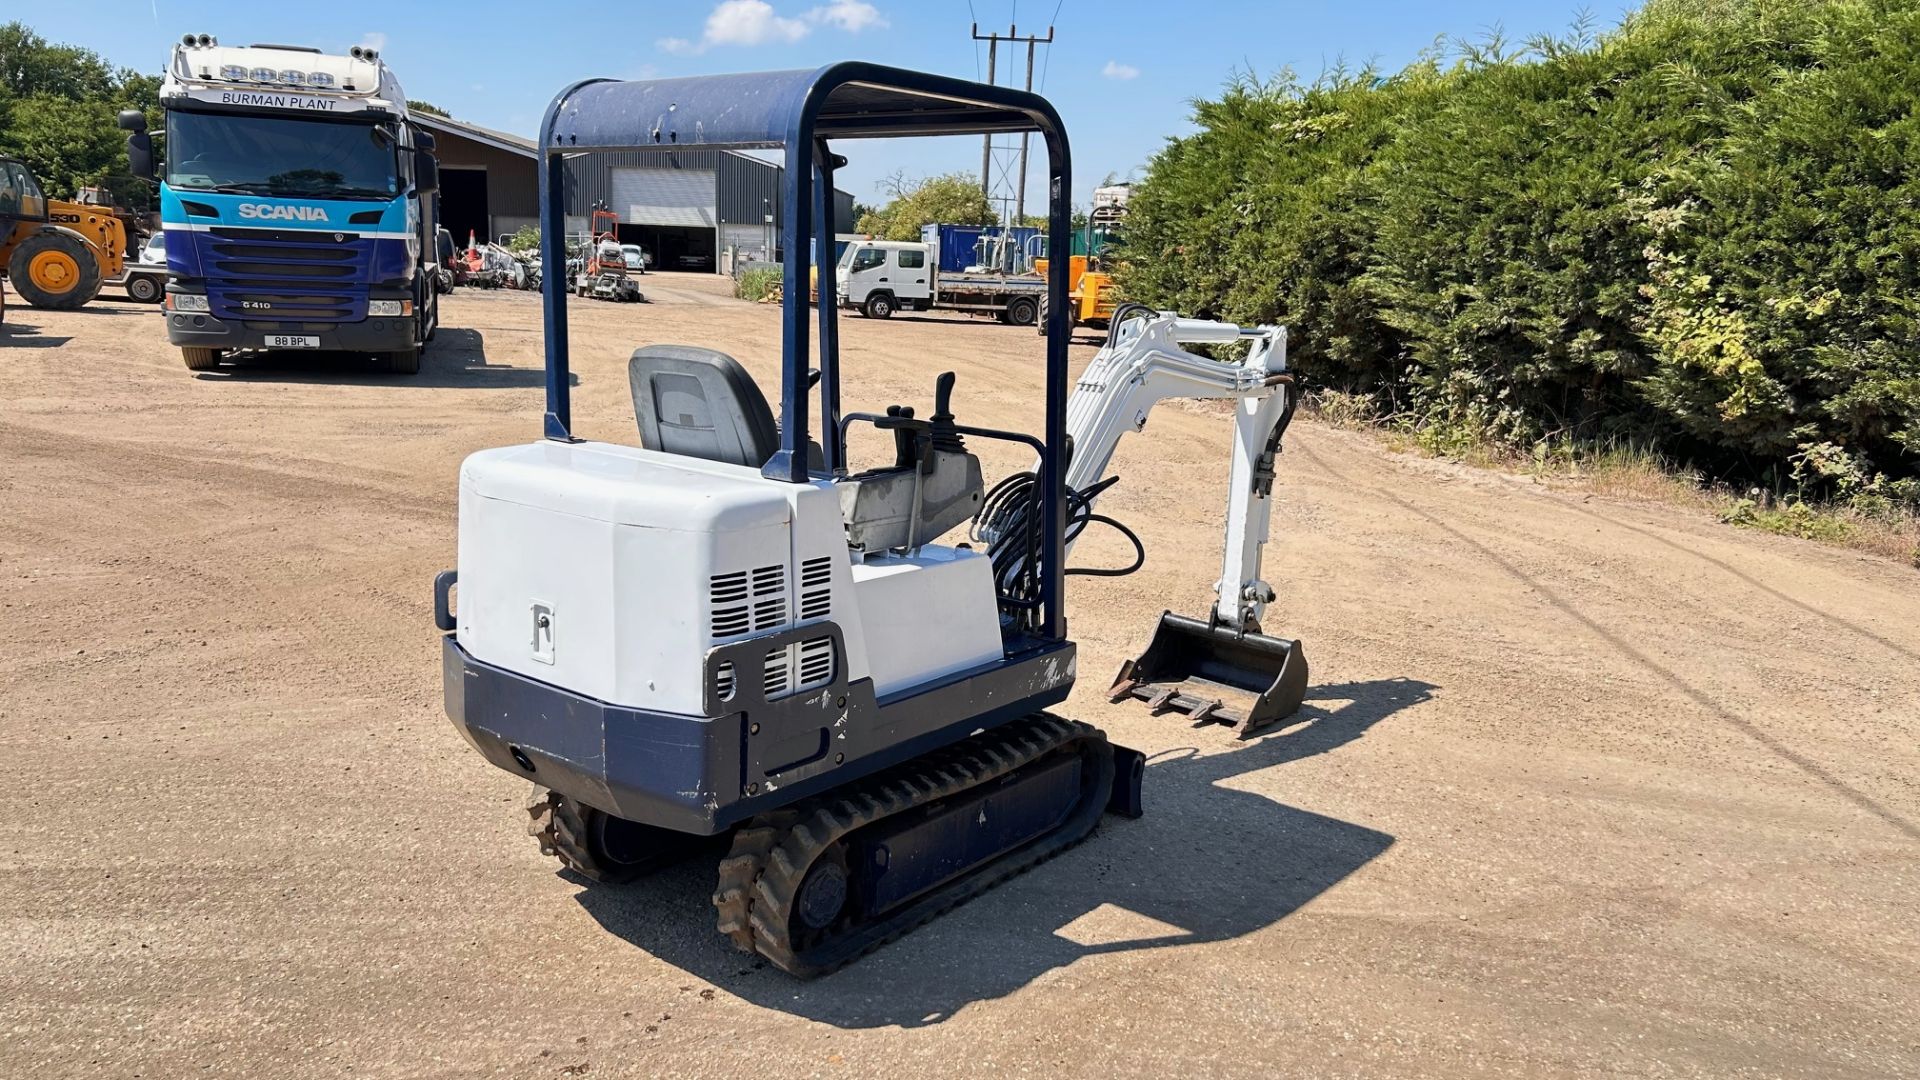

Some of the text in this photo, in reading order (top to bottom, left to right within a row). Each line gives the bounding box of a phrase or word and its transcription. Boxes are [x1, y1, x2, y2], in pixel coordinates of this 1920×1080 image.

[222, 92, 336, 110] BURMAN PLANT
[50, 213, 80, 223] 530
[238, 203, 329, 222] SCANIA
[242, 301, 250, 309] G
[274, 336, 310, 347] 88 BPL
